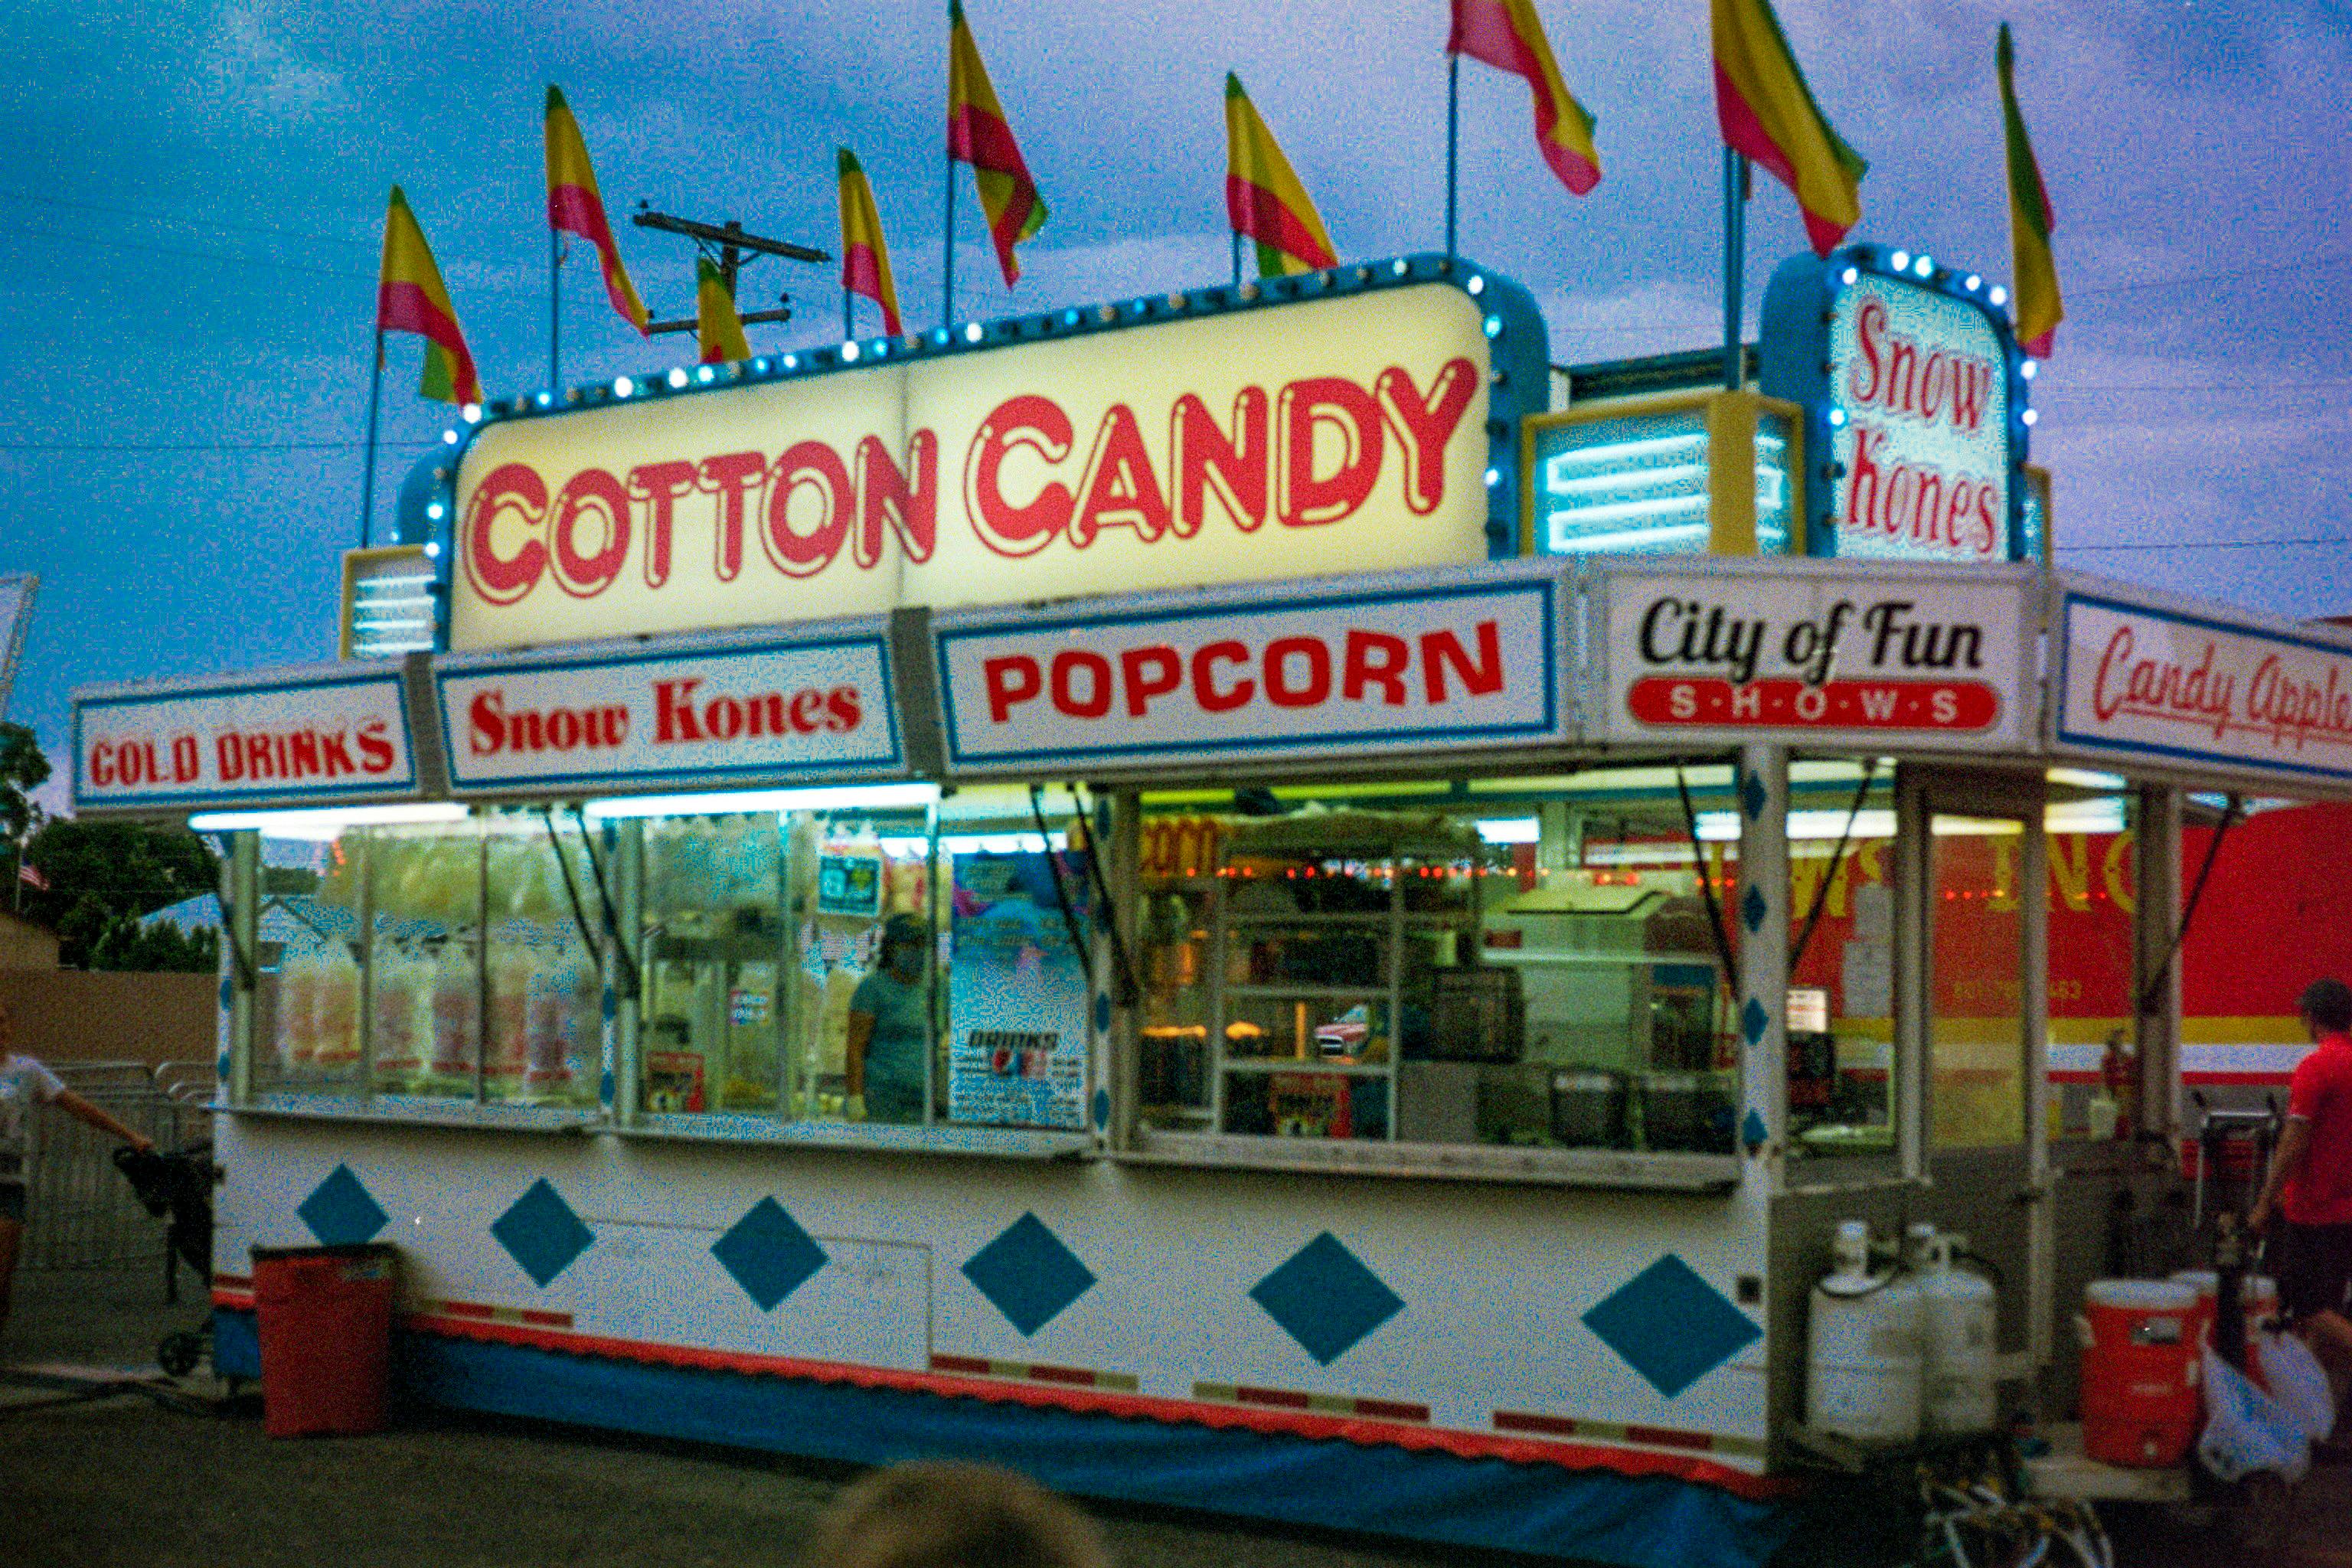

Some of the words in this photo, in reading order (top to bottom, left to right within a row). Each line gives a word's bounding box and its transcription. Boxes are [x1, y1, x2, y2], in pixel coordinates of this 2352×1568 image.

[1851, 299, 1992, 430] Snow
[462, 427, 939, 606] COTTON
[963, 357, 1479, 560] CANDY
[984, 619, 1504, 724] POPCORN
[1640, 596, 1767, 687] City
[1782, 599, 1856, 688] of
[1862, 600, 1983, 669] Fun
[2092, 625, 2235, 740] Candy
[89, 735, 199, 787] COLD
[214, 720, 395, 782] DRINKS
[467, 689, 628, 757] Snow
[651, 677, 864, 746] Kones
